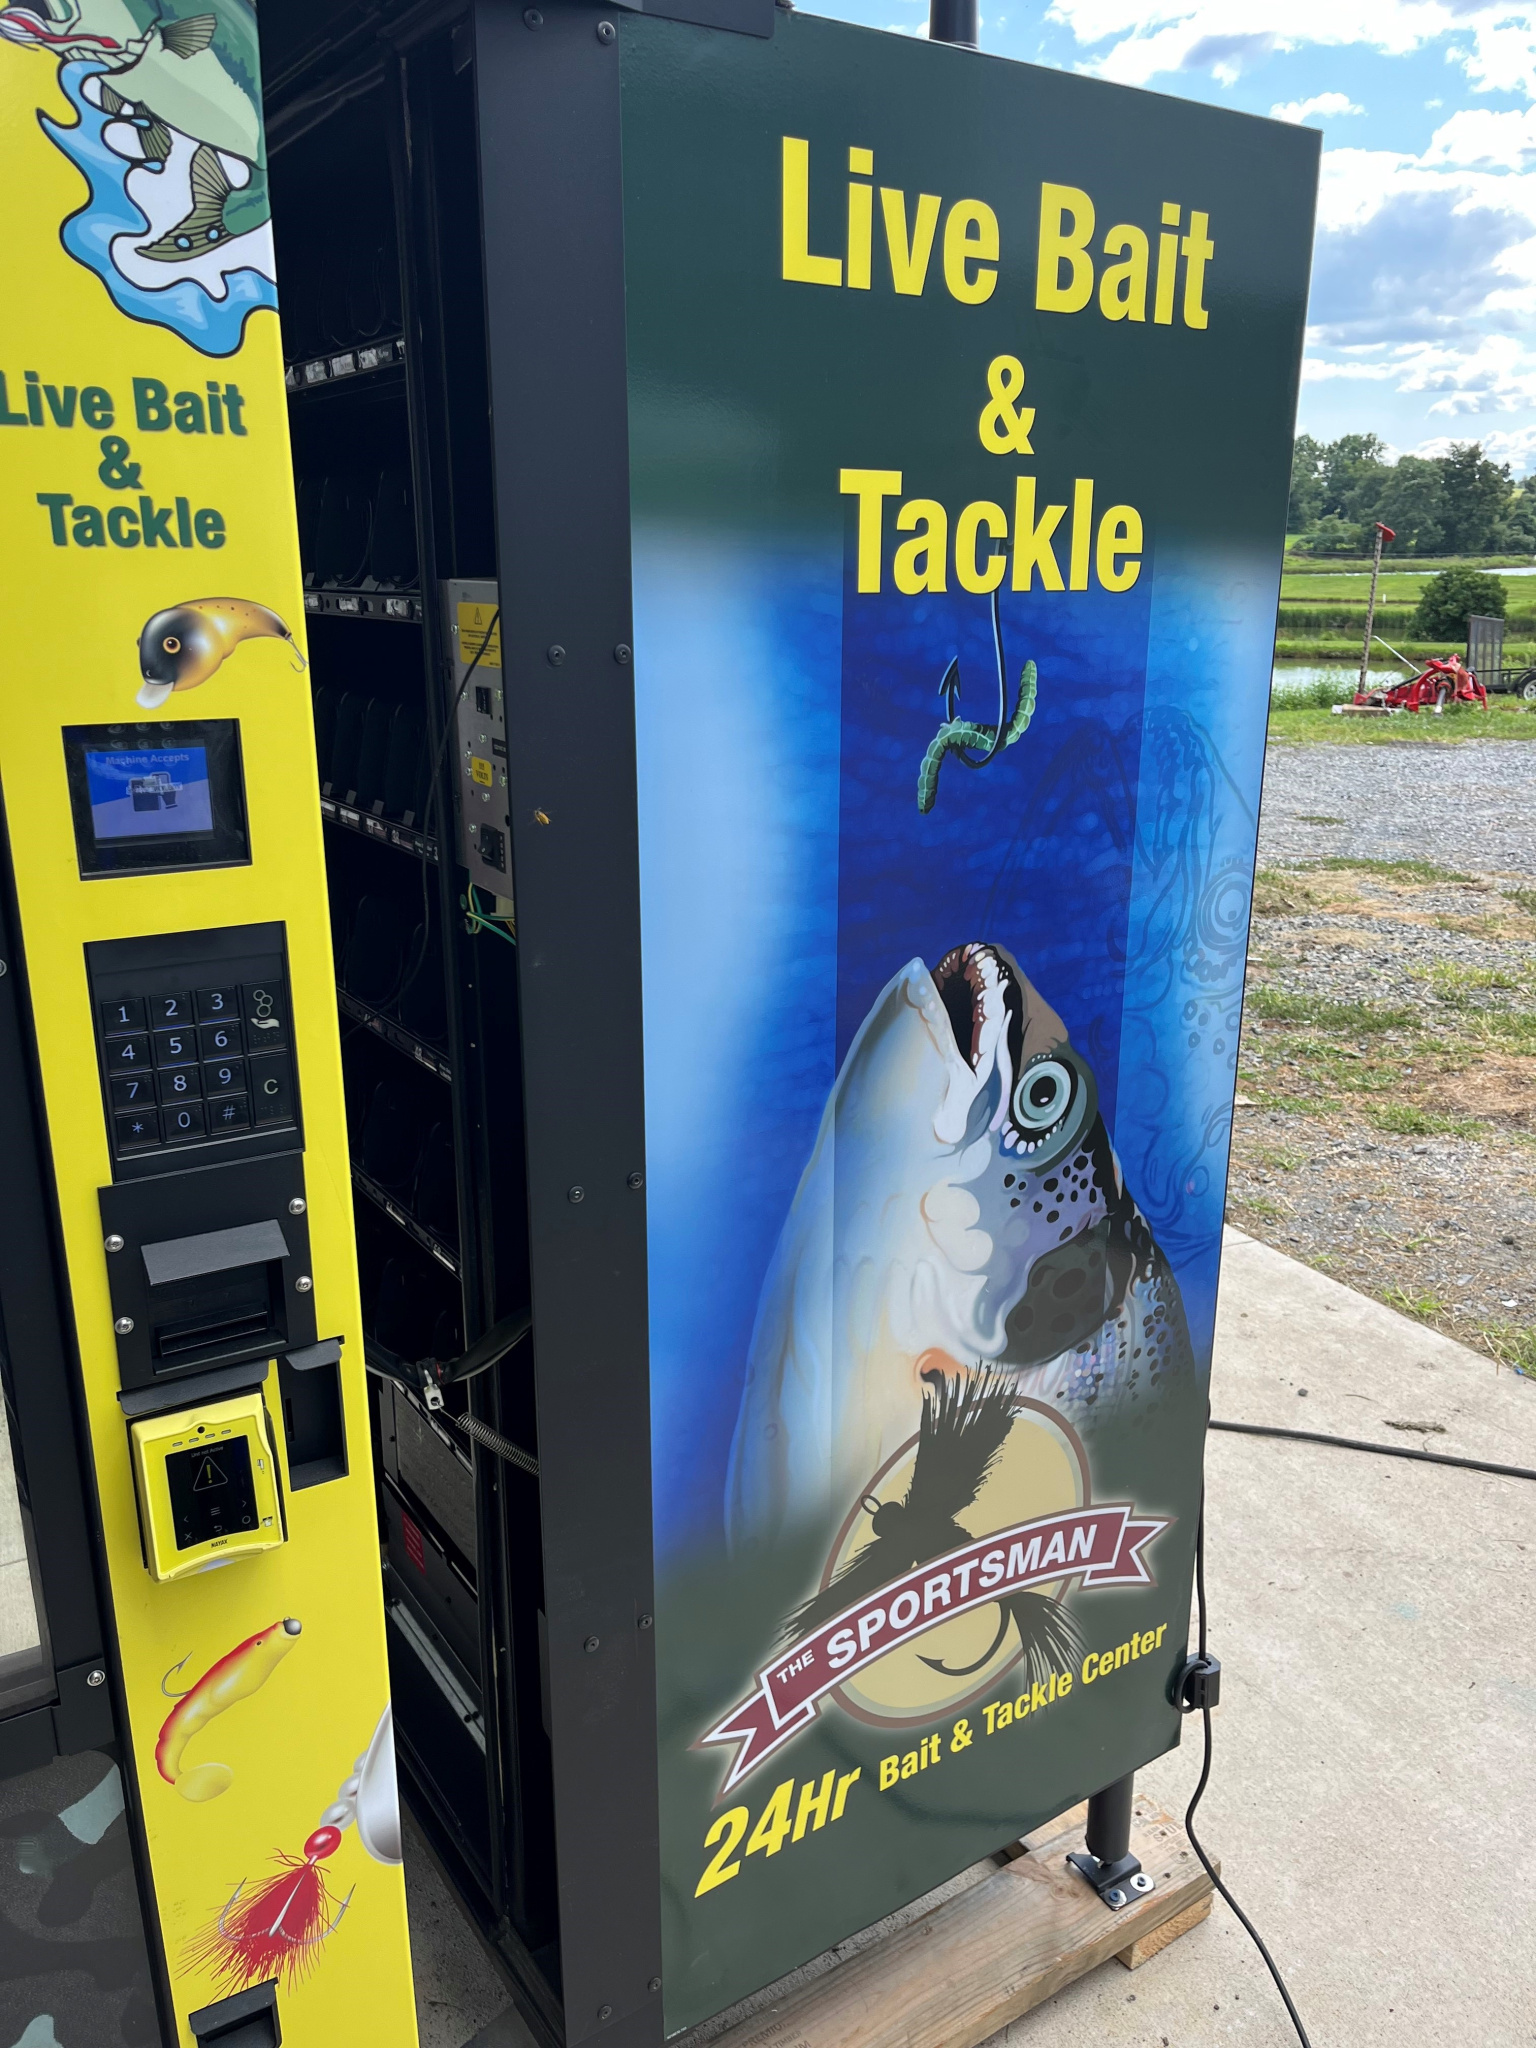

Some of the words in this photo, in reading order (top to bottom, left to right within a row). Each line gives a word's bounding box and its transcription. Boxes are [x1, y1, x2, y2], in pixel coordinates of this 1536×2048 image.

[782, 136, 1000, 305] Live
[1035, 182, 1215, 330] Bait
[0, 369, 115, 430] Live
[132, 376, 248, 436] Bait
[979, 354, 1036, 455] &
[98, 435, 144, 490] &
[36, 492, 227, 549] Tackle
[839, 468, 1144, 596] Tackle
[105, 754, 149, 766] Machine
[150, 753, 190, 764] Accepts
[118, 1006, 130, 1023] 1
[164, 999, 179, 1017] 2
[211, 993, 224, 1010] 3
[121, 1044, 136, 1060] 4
[169, 1037, 183, 1054] 5
[215, 1030, 228, 1047] 6
[126, 1082, 139, 1099] 7
[173, 1075, 187, 1092] 8
[218, 1067, 232, 1084] 9
[263, 1079, 279, 1095] C
[177, 1112, 191, 1128] 0
[222, 1104, 236, 1120] #
[210, 1538, 228, 1548] NAYAX
[776, 1649, 815, 1685] THE
[826, 1523, 1097, 1669] SPORTSMAN
[694, 1766, 862, 1898] 24Hr
[878, 1734, 942, 1792] Bait
[950, 1716, 973, 1753] &
[982, 1669, 1073, 1737] Tackle
[1081, 1622, 1168, 1686] Center
[742, 2021, 790, 2047] PREMIU
